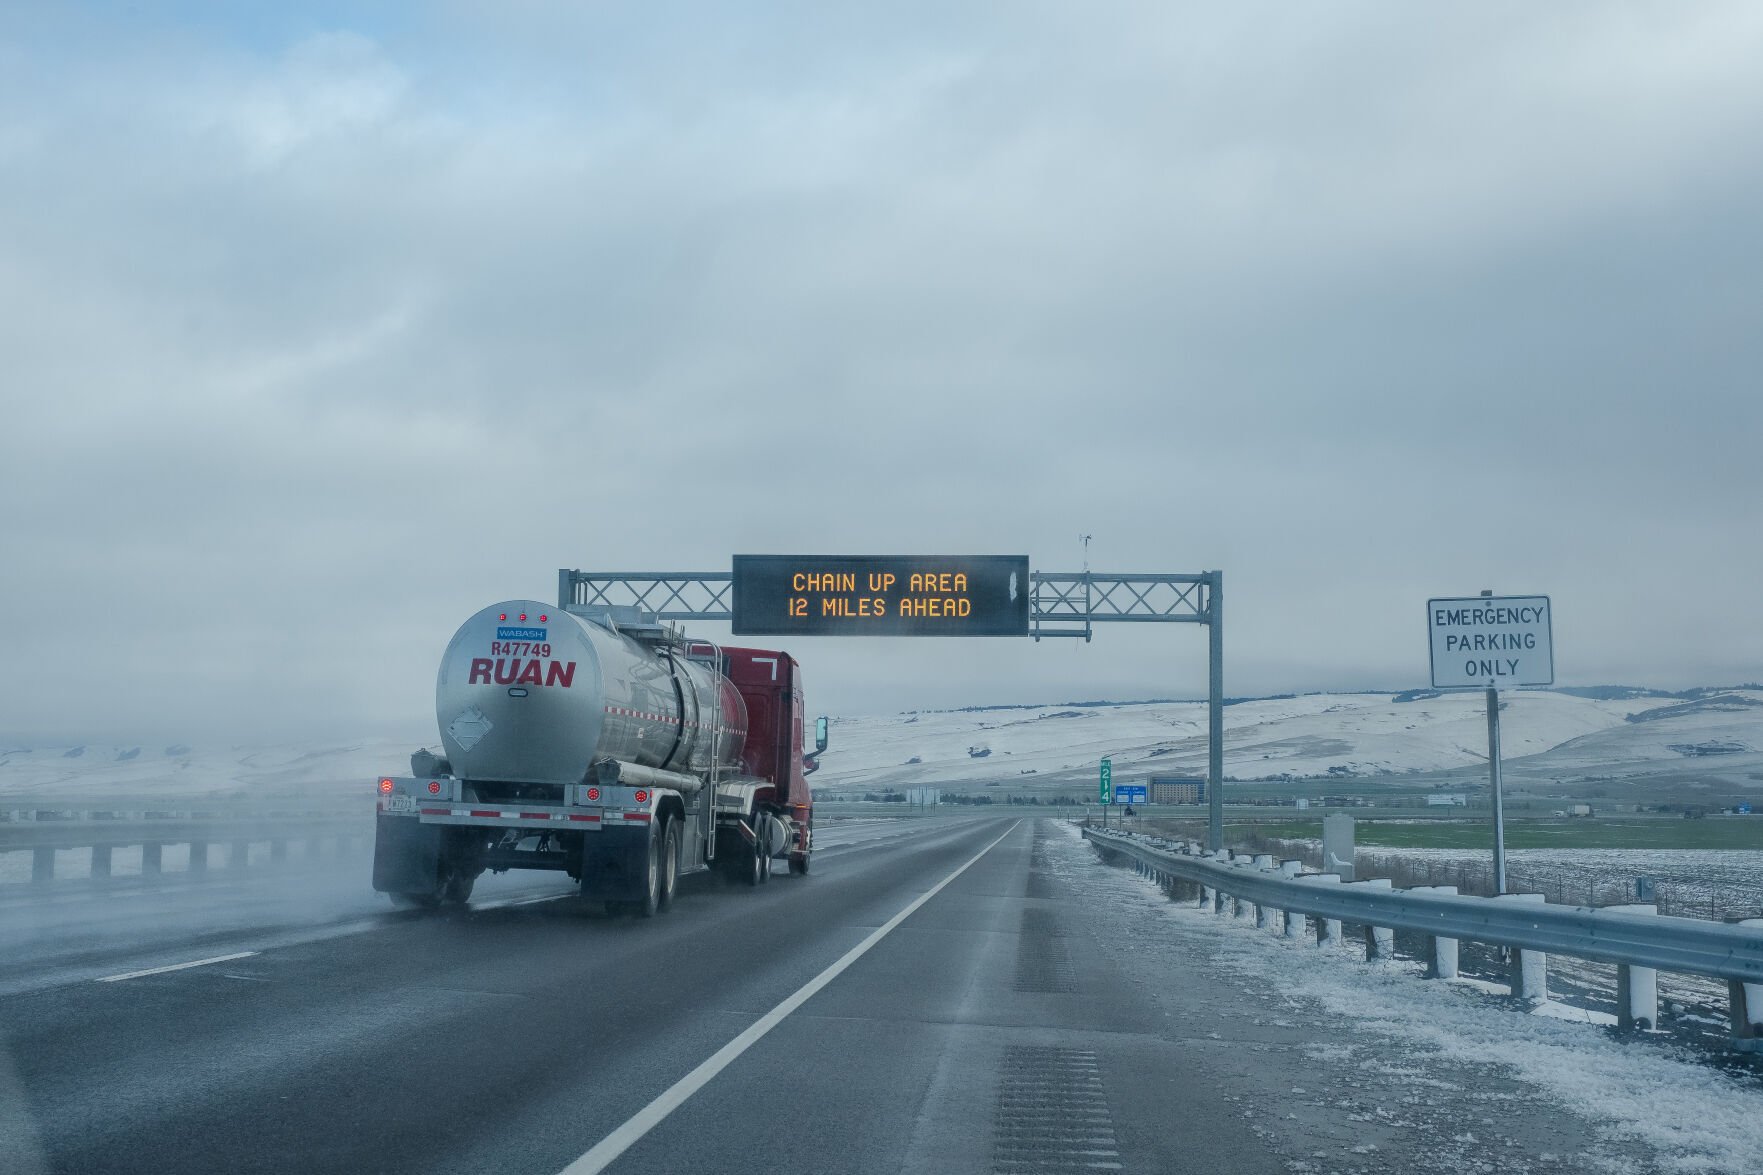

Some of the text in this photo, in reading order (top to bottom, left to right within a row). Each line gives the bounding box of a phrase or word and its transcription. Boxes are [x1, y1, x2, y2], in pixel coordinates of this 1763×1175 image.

[793, 573, 968, 592] CHAIN UP AREA
[789, 598, 971, 616] 12 MILES AHEAD
[1435, 607, 1544, 626] EMERGENCY
[500, 629, 543, 638] WABASH
[1446, 633, 1536, 651] PARKING
[491, 641, 551, 657] R47749
[468, 658, 576, 687] RUAN
[1465, 659, 1520, 676] ONLY
